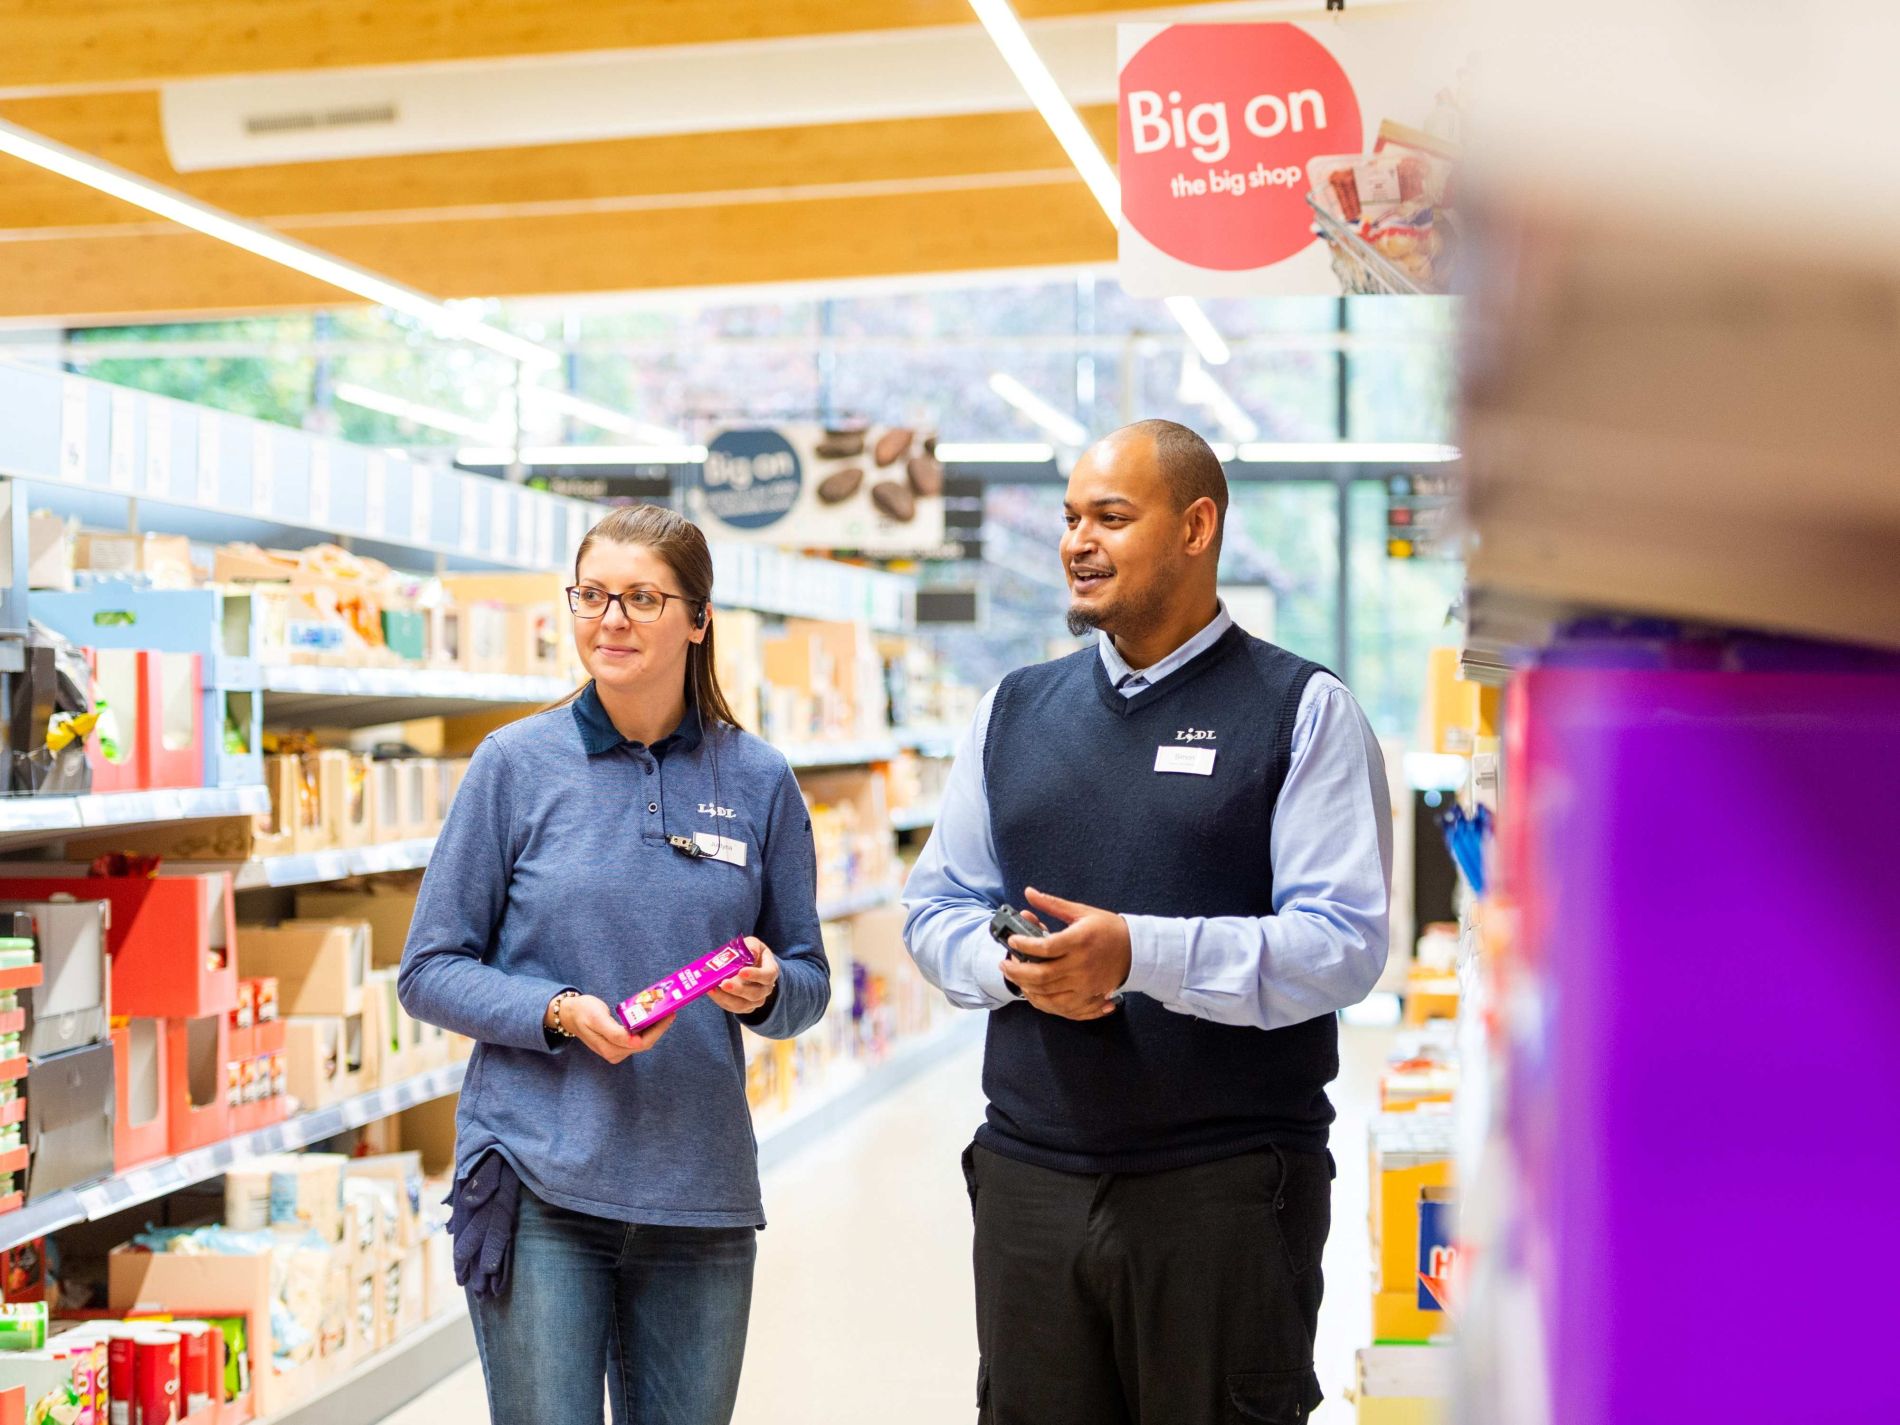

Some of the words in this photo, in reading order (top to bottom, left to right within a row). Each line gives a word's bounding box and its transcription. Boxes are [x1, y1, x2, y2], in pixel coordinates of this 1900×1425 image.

[1128, 90, 1231, 163] Big
[1244, 88, 1327, 138] on
[1171, 173, 1206, 199] the
[1209, 168, 1246, 196] big
[1248, 162, 1302, 190] shop
